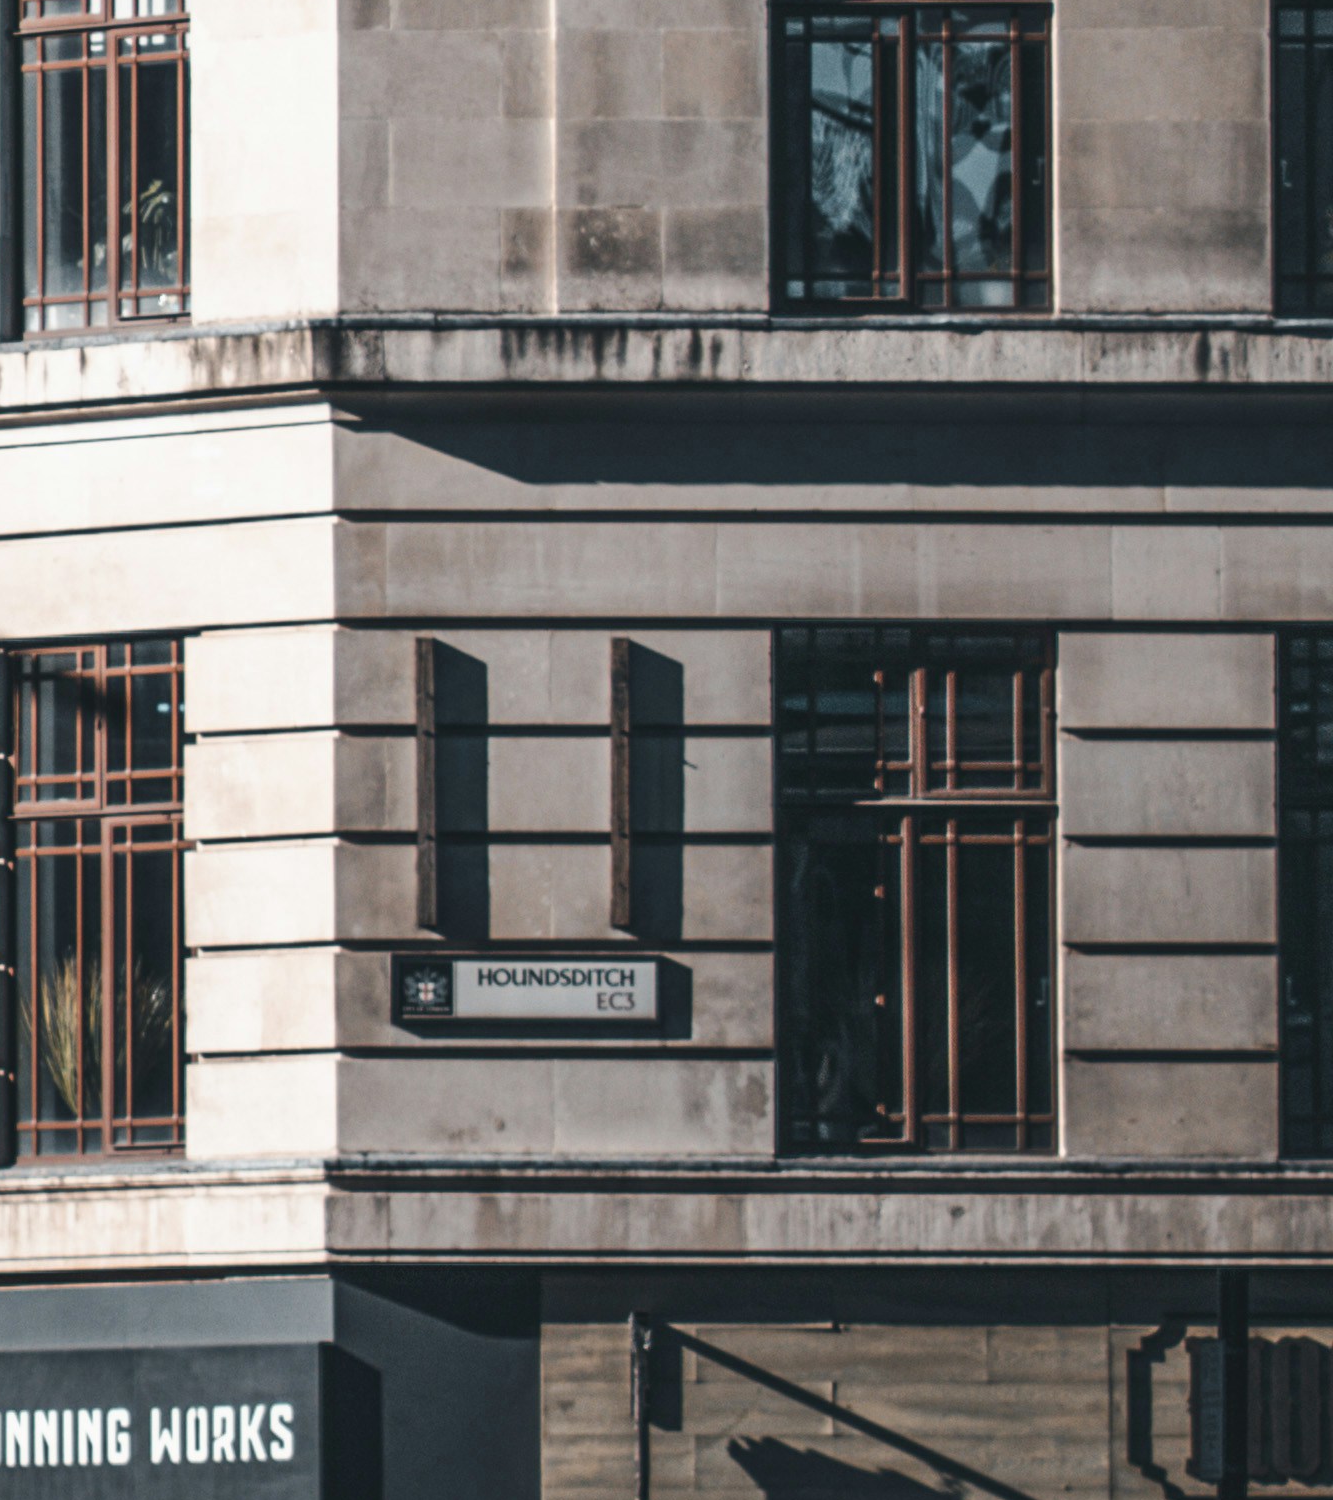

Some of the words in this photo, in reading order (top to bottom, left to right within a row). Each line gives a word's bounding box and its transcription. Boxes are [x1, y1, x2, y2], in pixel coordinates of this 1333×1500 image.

[477, 967, 636, 988] HOUNDSDITCH
[596, 991, 636, 1012] EC3
[150, 1402, 295, 1465] WORKS
